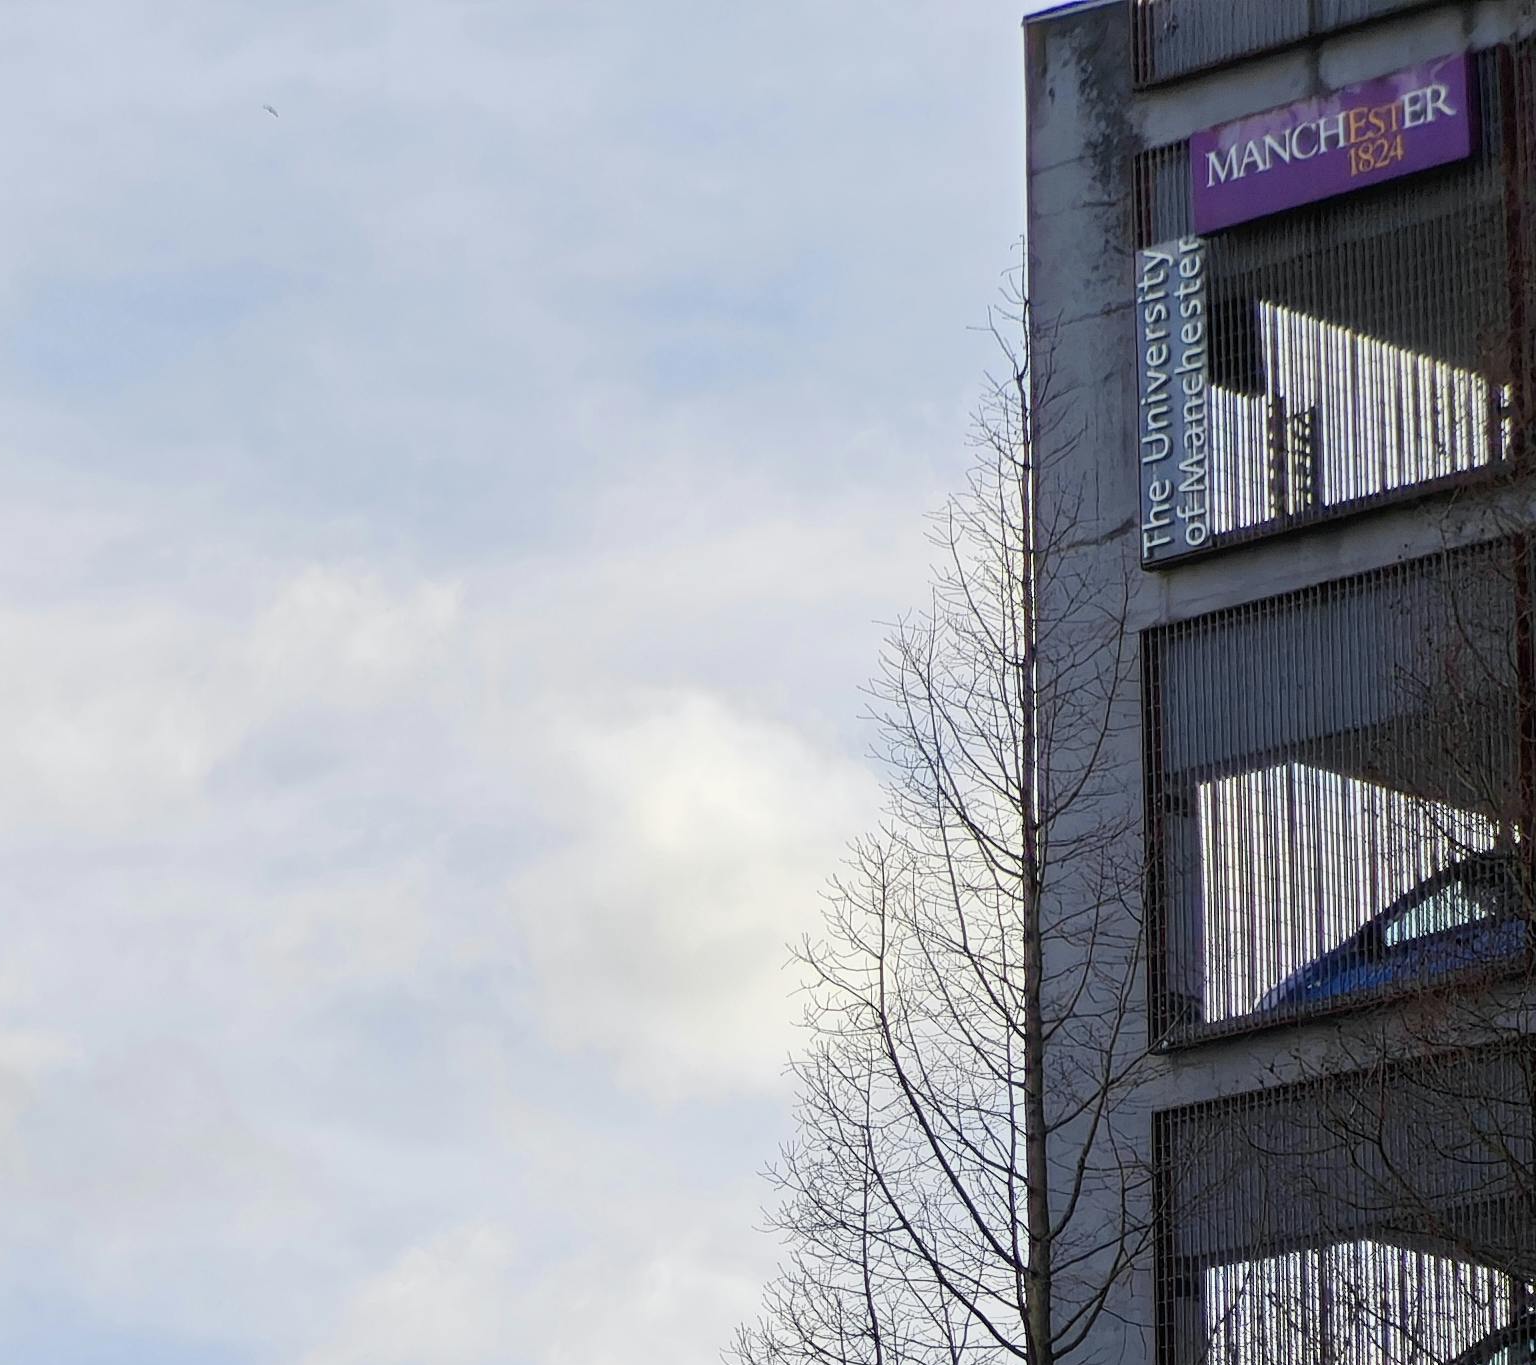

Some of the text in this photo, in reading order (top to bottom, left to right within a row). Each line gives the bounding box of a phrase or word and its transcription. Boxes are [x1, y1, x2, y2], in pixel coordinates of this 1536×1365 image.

[1206, 84, 1457, 188] MANCHESTER
[1348, 135, 1405, 178] 1824
[1138, 250, 1174, 558] The University
[1173, 238, 1207, 547] of Manchester
